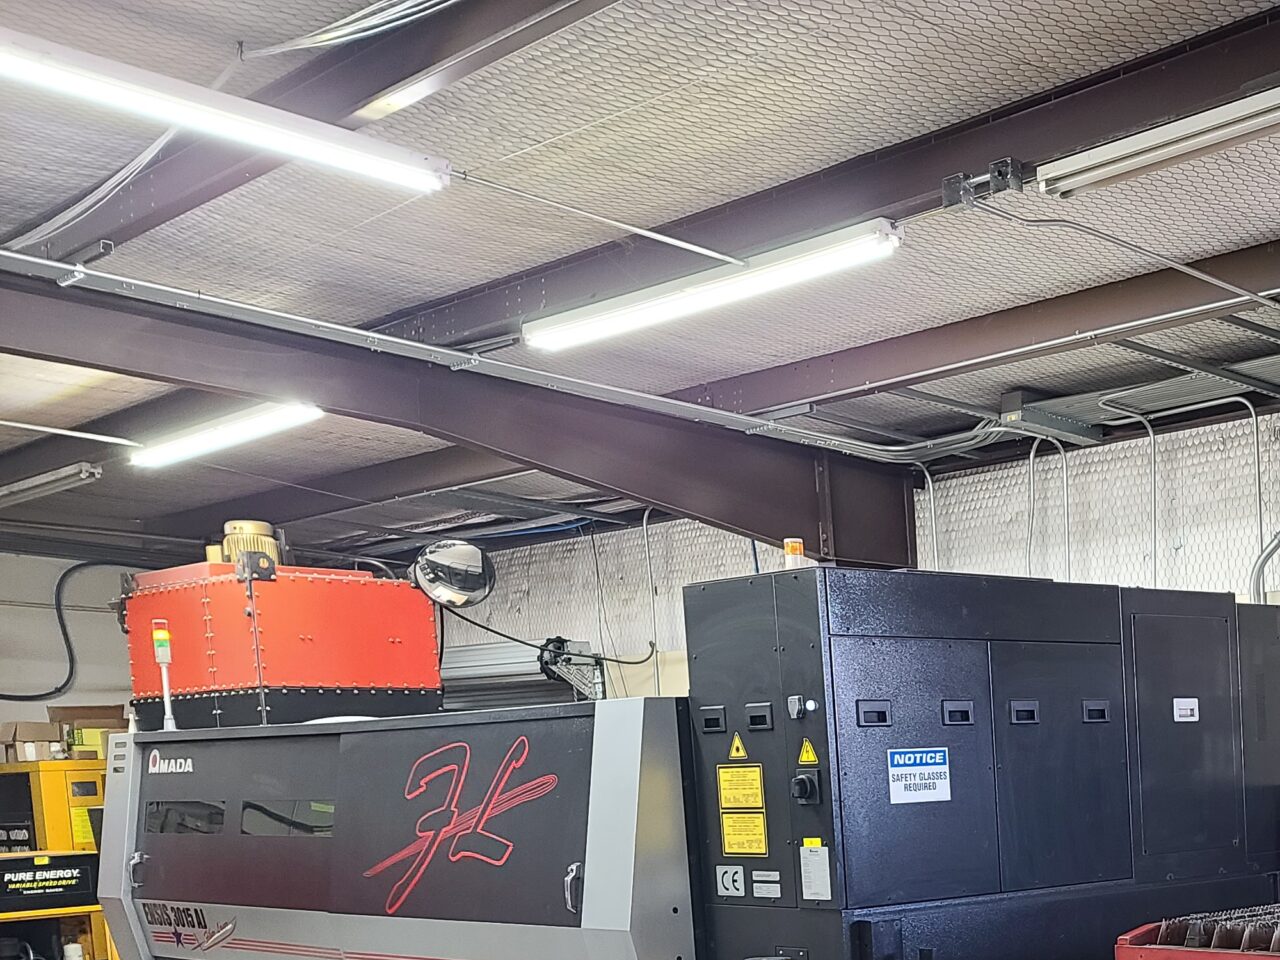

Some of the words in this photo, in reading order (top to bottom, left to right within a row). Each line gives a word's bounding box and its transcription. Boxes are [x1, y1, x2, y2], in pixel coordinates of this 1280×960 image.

[148, 749, 194, 774] AMADA
[893, 752, 945, 765] NOTICE
[891, 772, 917, 783] SAFETY
[919, 771, 948, 782] GLASSES
[903, 781, 937, 792] REQUIRED
[4, 872, 34, 882] PURE
[8, 881, 37, 889] VARIABLE
[142, 902, 172, 927] ENSIS
[170, 905, 196, 929] 3015
